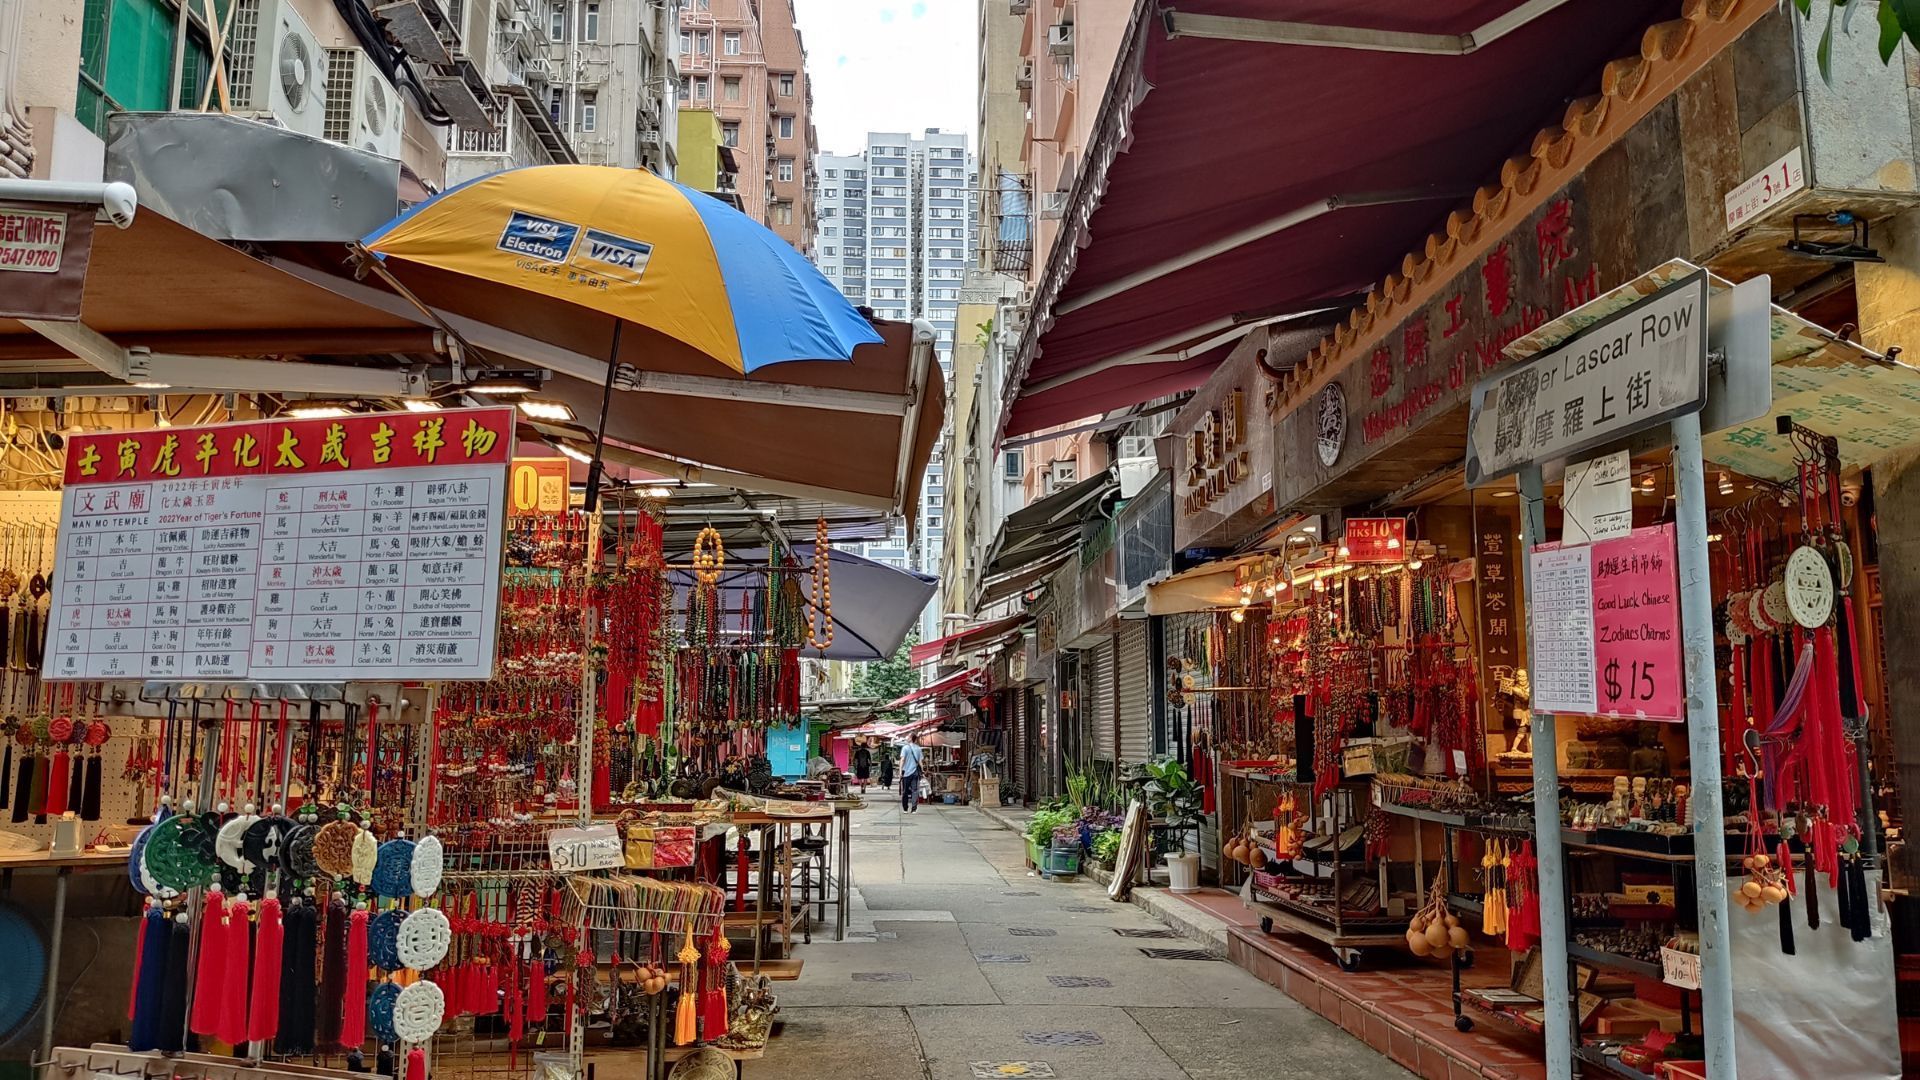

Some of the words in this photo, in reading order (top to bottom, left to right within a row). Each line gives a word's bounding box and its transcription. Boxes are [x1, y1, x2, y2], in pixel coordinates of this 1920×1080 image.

[526, 220, 560, 237] VISA
[505, 236, 563, 259] Electron
[0, 248, 26, 265] 547
[590, 242, 639, 268] VISA
[1448, 350, 1467, 391] of
[1564, 262, 1599, 310] Art
[1563, 331, 1632, 383] Lascar
[1640, 303, 1693, 348] Row
[1533, 370, 1651, 449] 摩羅上街
[162, 478, 243, 492] 2022年壬寅虎年
[279, 491, 289, 503] 蛇
[1184, 487, 1205, 518] HING
[1205, 470, 1223, 504] FAT
[80, 489, 146, 513] 文武廟
[72, 520, 89, 529] MAN
[95, 519, 108, 528] MO
[112, 517, 149, 527] TEMPLE
[158, 514, 192, 524] 2022Year
[194, 512, 203, 521] of
[204, 511, 228, 522] Tiger's
[230, 510, 262, 519] Fortune
[276, 517, 287, 529] 馬
[320, 514, 340, 526] 大吉
[201, 529, 250, 541] 助運吉祥物
[1349, 521, 1391, 538] HK$10
[75, 534, 93, 547] 生肖
[317, 541, 337, 553] 大吉
[274, 542, 285, 553] 羊
[77, 560, 85, 572] 鼠
[119, 559, 127, 569] 吉
[421, 561, 463, 574] 如意吉祥
[311, 565, 343, 578] 沖太歲
[74, 584, 83, 595] 牛
[116, 583, 125, 594] 吉
[201, 579, 236, 591] 招財進寶
[269, 592, 280, 604] 雞
[319, 591, 329, 603] 吉
[419, 588, 462, 601] 開心笑佛
[1597, 594, 1617, 611] Good
[1617, 591, 1640, 610] Luck
[1641, 587, 1671, 606] Chinese
[72, 608, 81, 620] 虎
[106, 607, 132, 620] 犯太歲
[268, 618, 278, 630] 狗
[312, 617, 333, 630] 大吉
[419, 615, 462, 628] 進寶麒麟
[113, 632, 121, 643] 吉
[197, 628, 232, 640] 年年有餘
[1599, 624, 1640, 644] Zodiacs
[1640, 622, 1671, 641] Charms
[264, 644, 274, 656] 豬
[304, 644, 336, 656] 害太歲
[415, 642, 458, 655] 消災葫蘆
[110, 658, 118, 669] 吉
[195, 654, 231, 666] 貴人助運
[554, 843, 588, 869] $10
